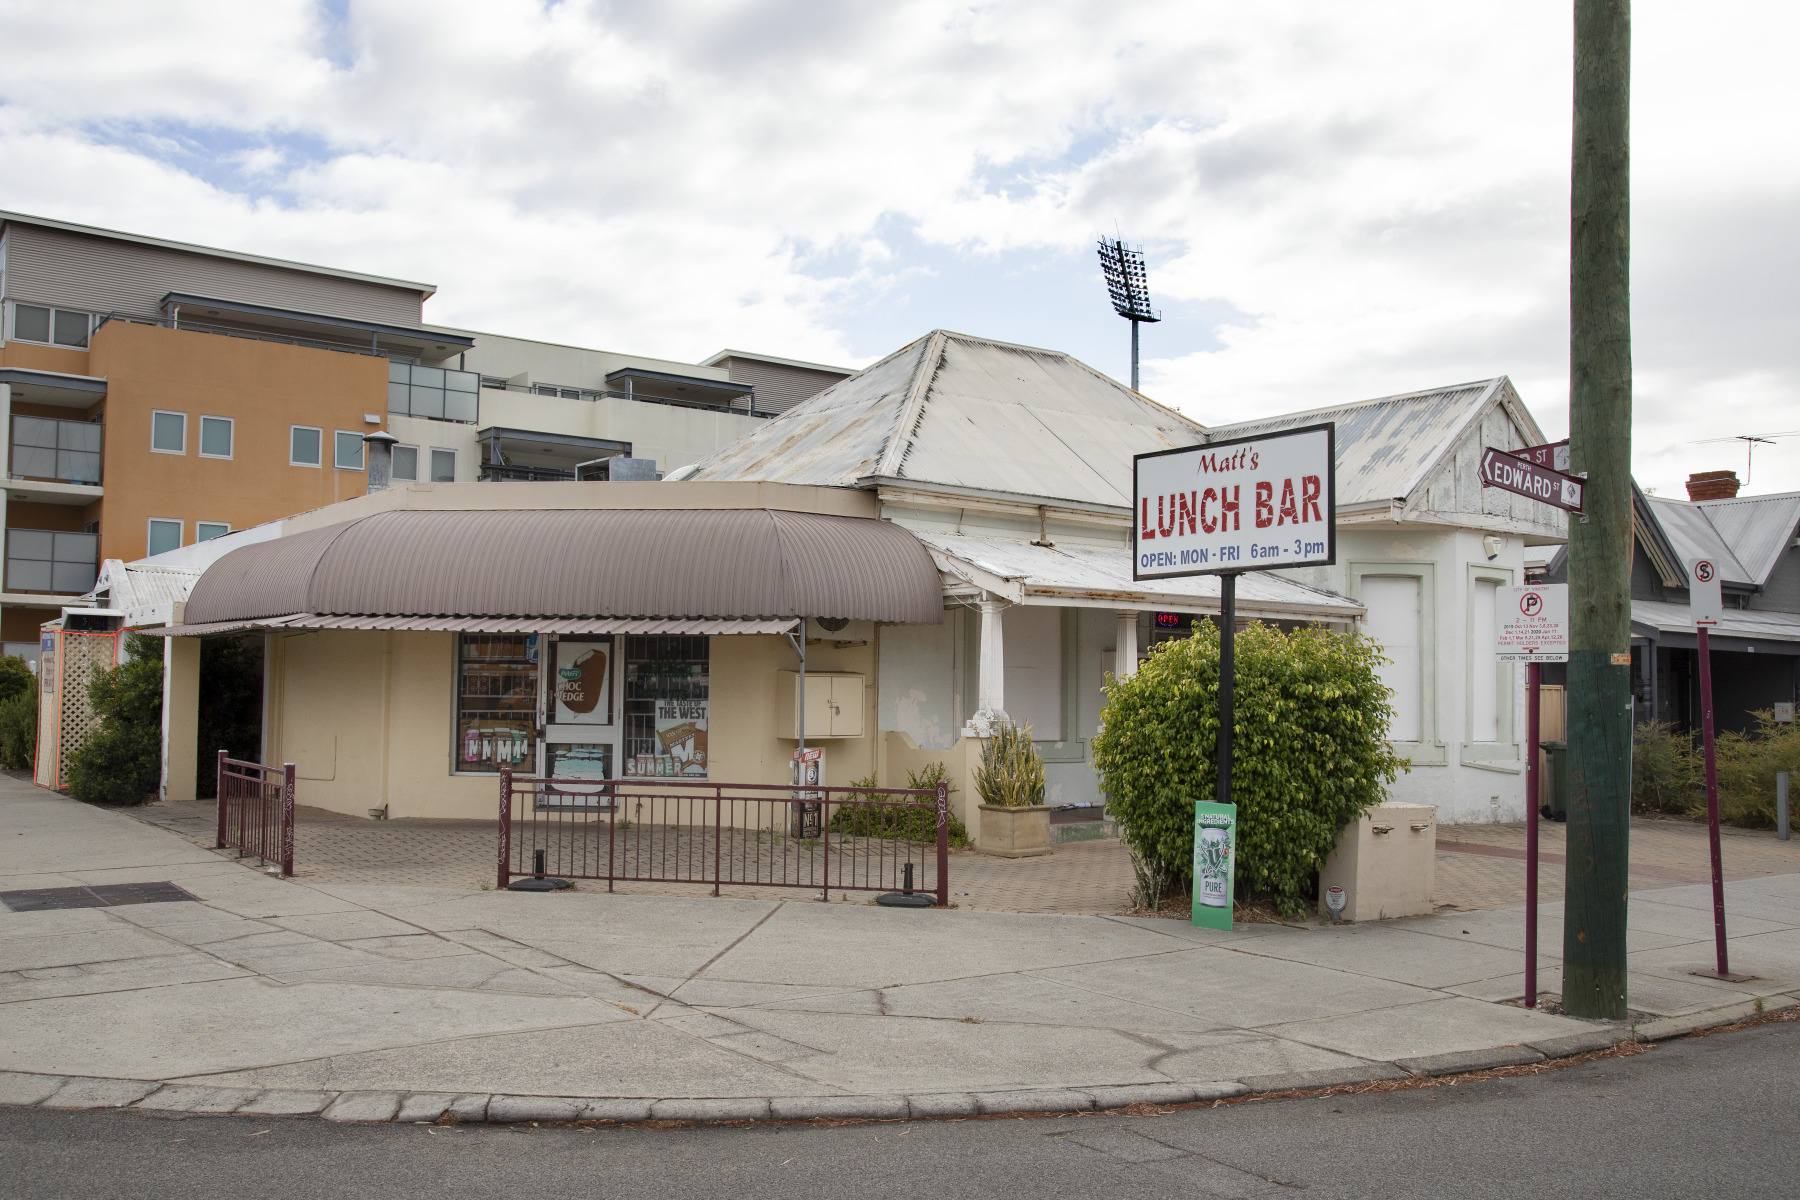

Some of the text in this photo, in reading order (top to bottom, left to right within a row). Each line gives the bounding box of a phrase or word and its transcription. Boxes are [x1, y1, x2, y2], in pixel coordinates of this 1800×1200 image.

[1197, 446, 1259, 475] Matt's
[1536, 449, 1547, 464] ST
[1517, 462, 1532, 472] PERTH
[1494, 462, 1560, 498] EDWARD ST
[1142, 474, 1323, 540] LUNCH BAR
[1141, 551, 1177, 568] OPEN:
[1180, 548, 1209, 565] MON
[1220, 545, 1240, 562] FRI
[1250, 543, 1280, 559] 6am
[1158, 614, 1178, 624] OPEN
[558, 682, 582, 691] CHOC
[658, 706, 706, 720] THE WEST
[627, 760, 682, 776] SUMMER
[1204, 881, 1222, 893] PURE
